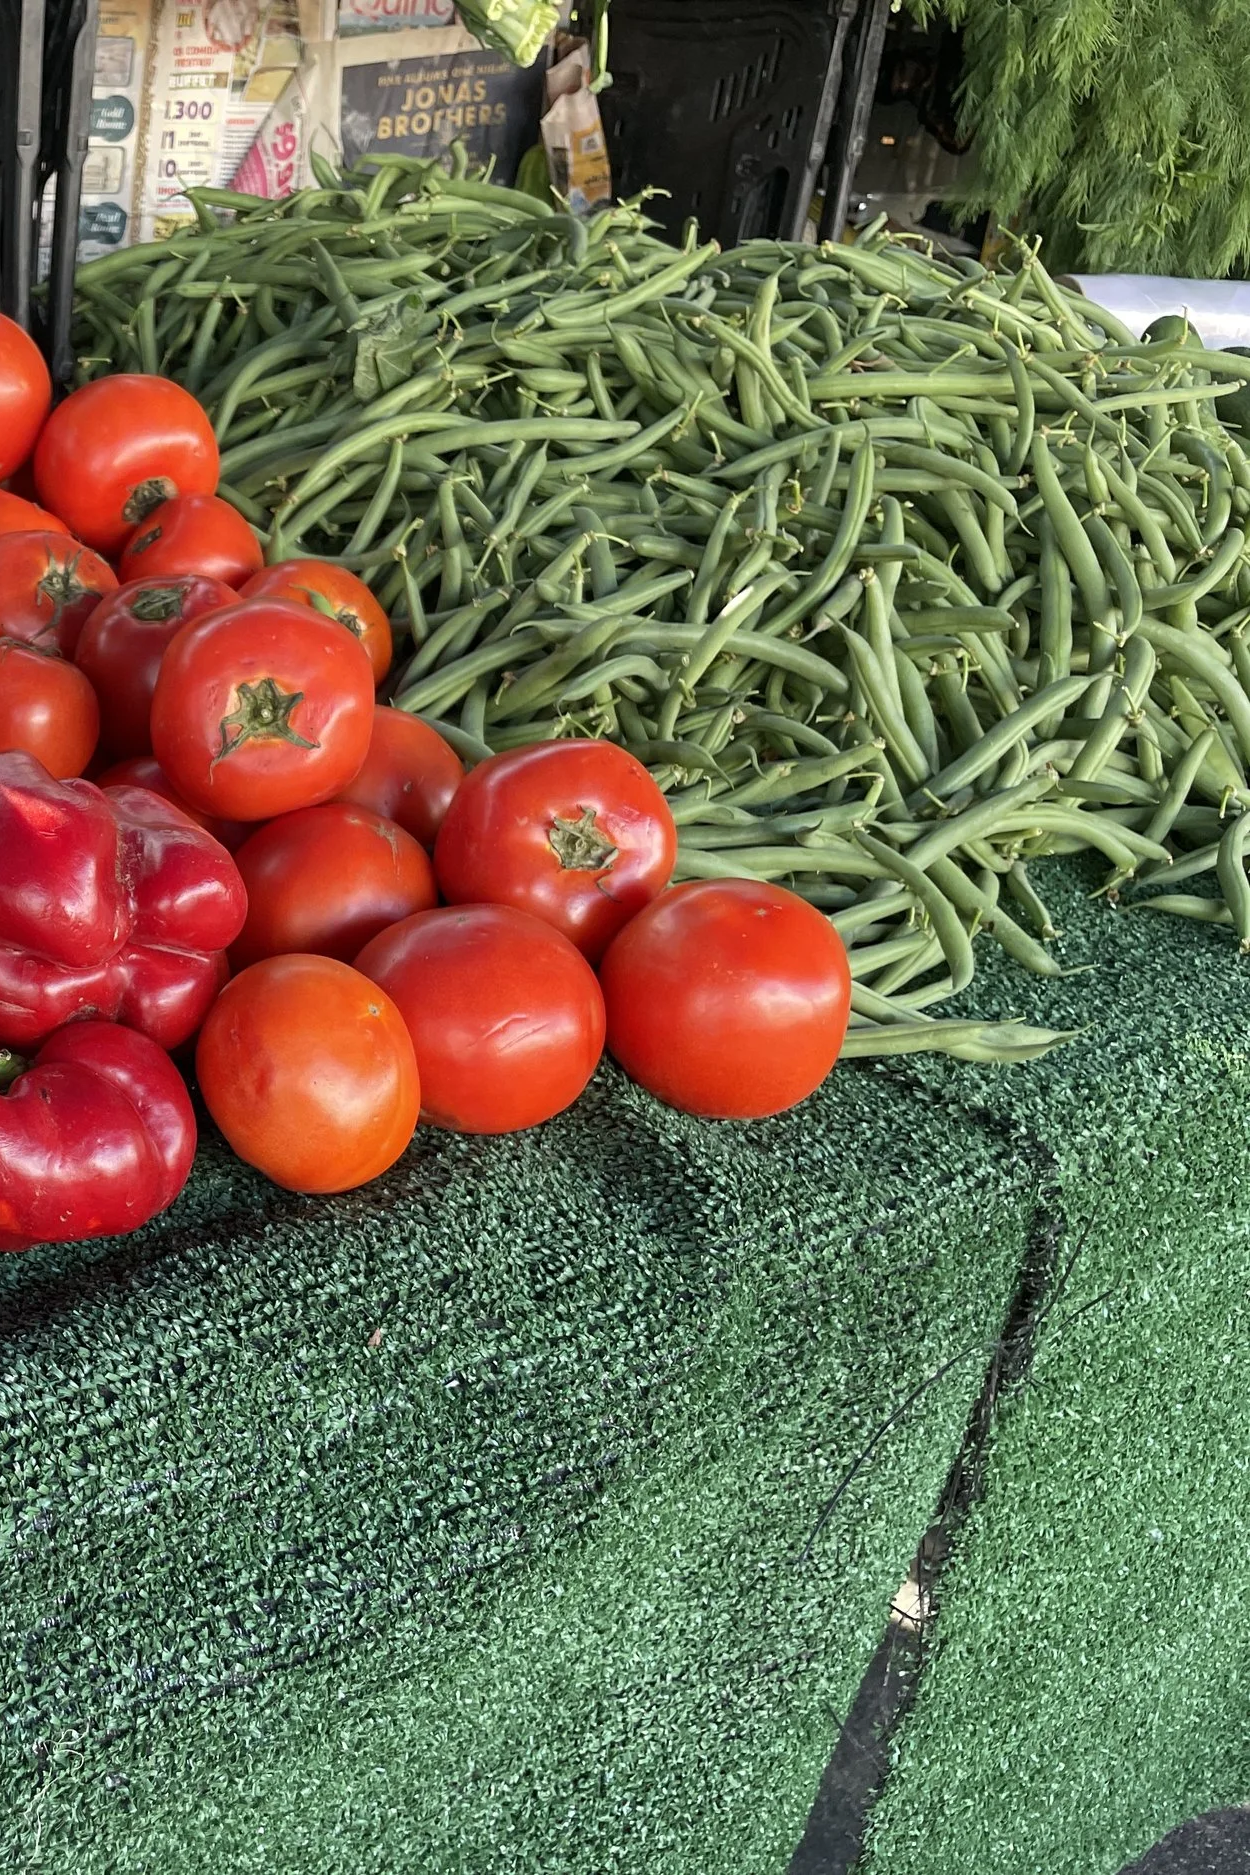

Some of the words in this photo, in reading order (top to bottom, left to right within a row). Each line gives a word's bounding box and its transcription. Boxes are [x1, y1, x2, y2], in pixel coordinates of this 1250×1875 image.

[168, 75, 217, 88] BUFFET
[401, 80, 487, 112] JONAS
[377, 103, 507, 140] BROTHERS
